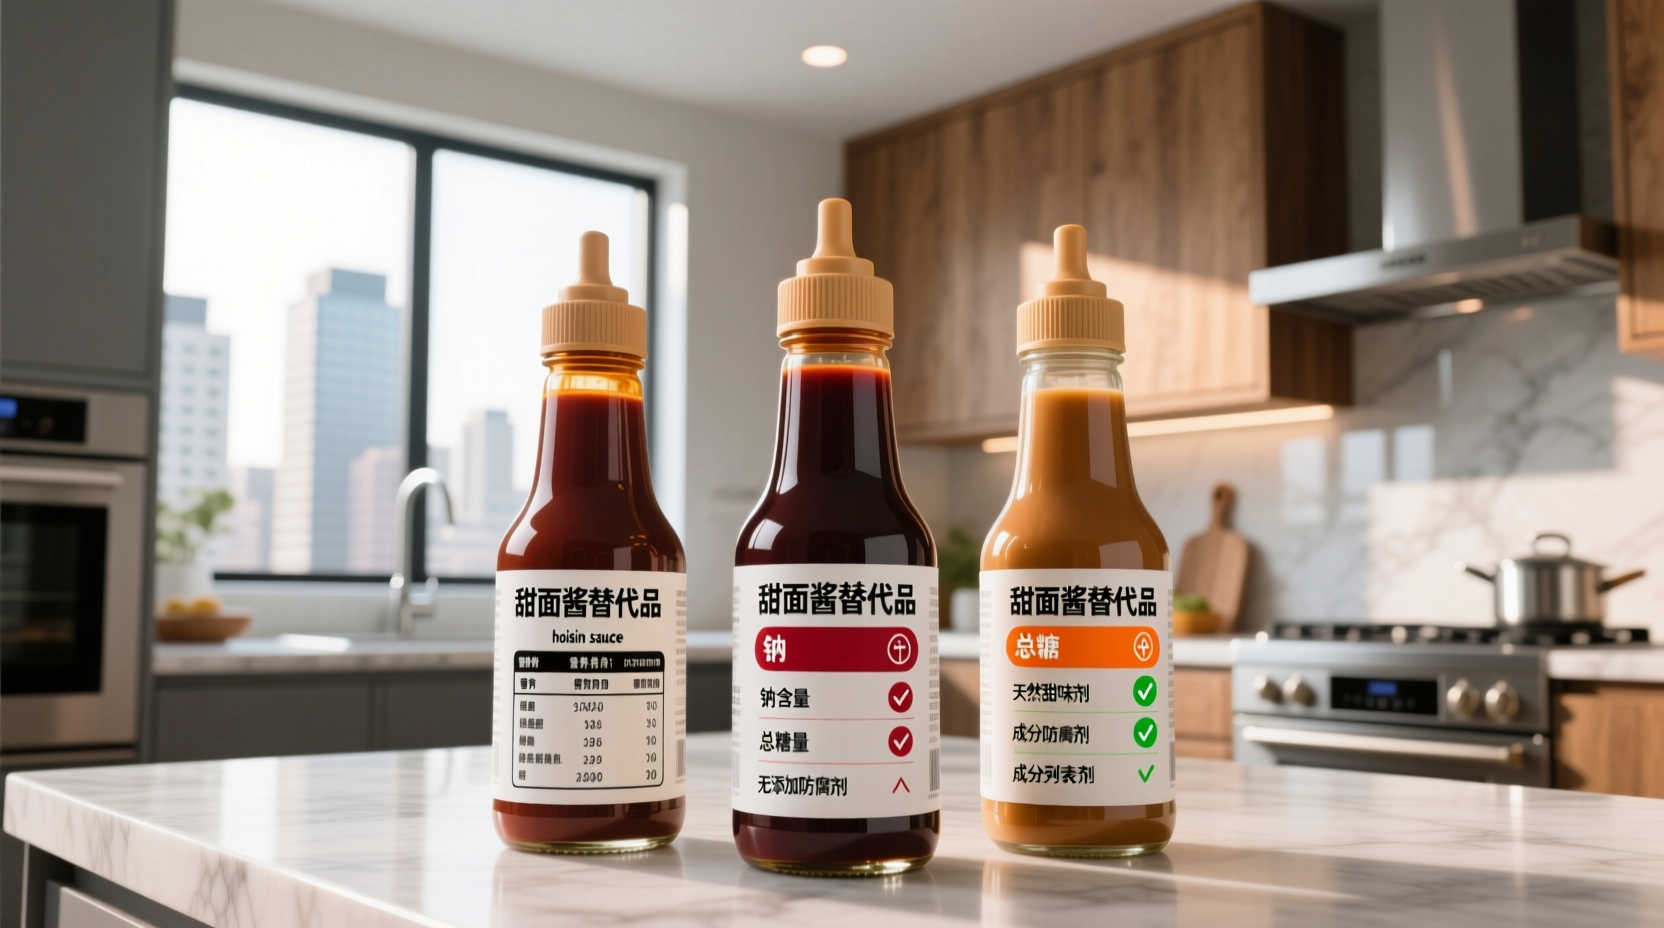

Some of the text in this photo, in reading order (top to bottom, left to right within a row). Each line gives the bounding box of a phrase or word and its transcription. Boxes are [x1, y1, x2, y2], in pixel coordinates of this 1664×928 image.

[515, 587, 661, 618] 甜面酱替代品
[758, 581, 916, 615] 甜面酱替代品
[1010, 585, 1157, 617] 甜面酱替代品
[552, 629, 624, 644] hoisin sauce
[763, 634, 786, 663] 钠
[1015, 632, 1060, 660] 总糖
[760, 686, 811, 709] 钠含量
[1012, 682, 1090, 703] 天然甜味剂
[759, 730, 810, 753] 总糖量
